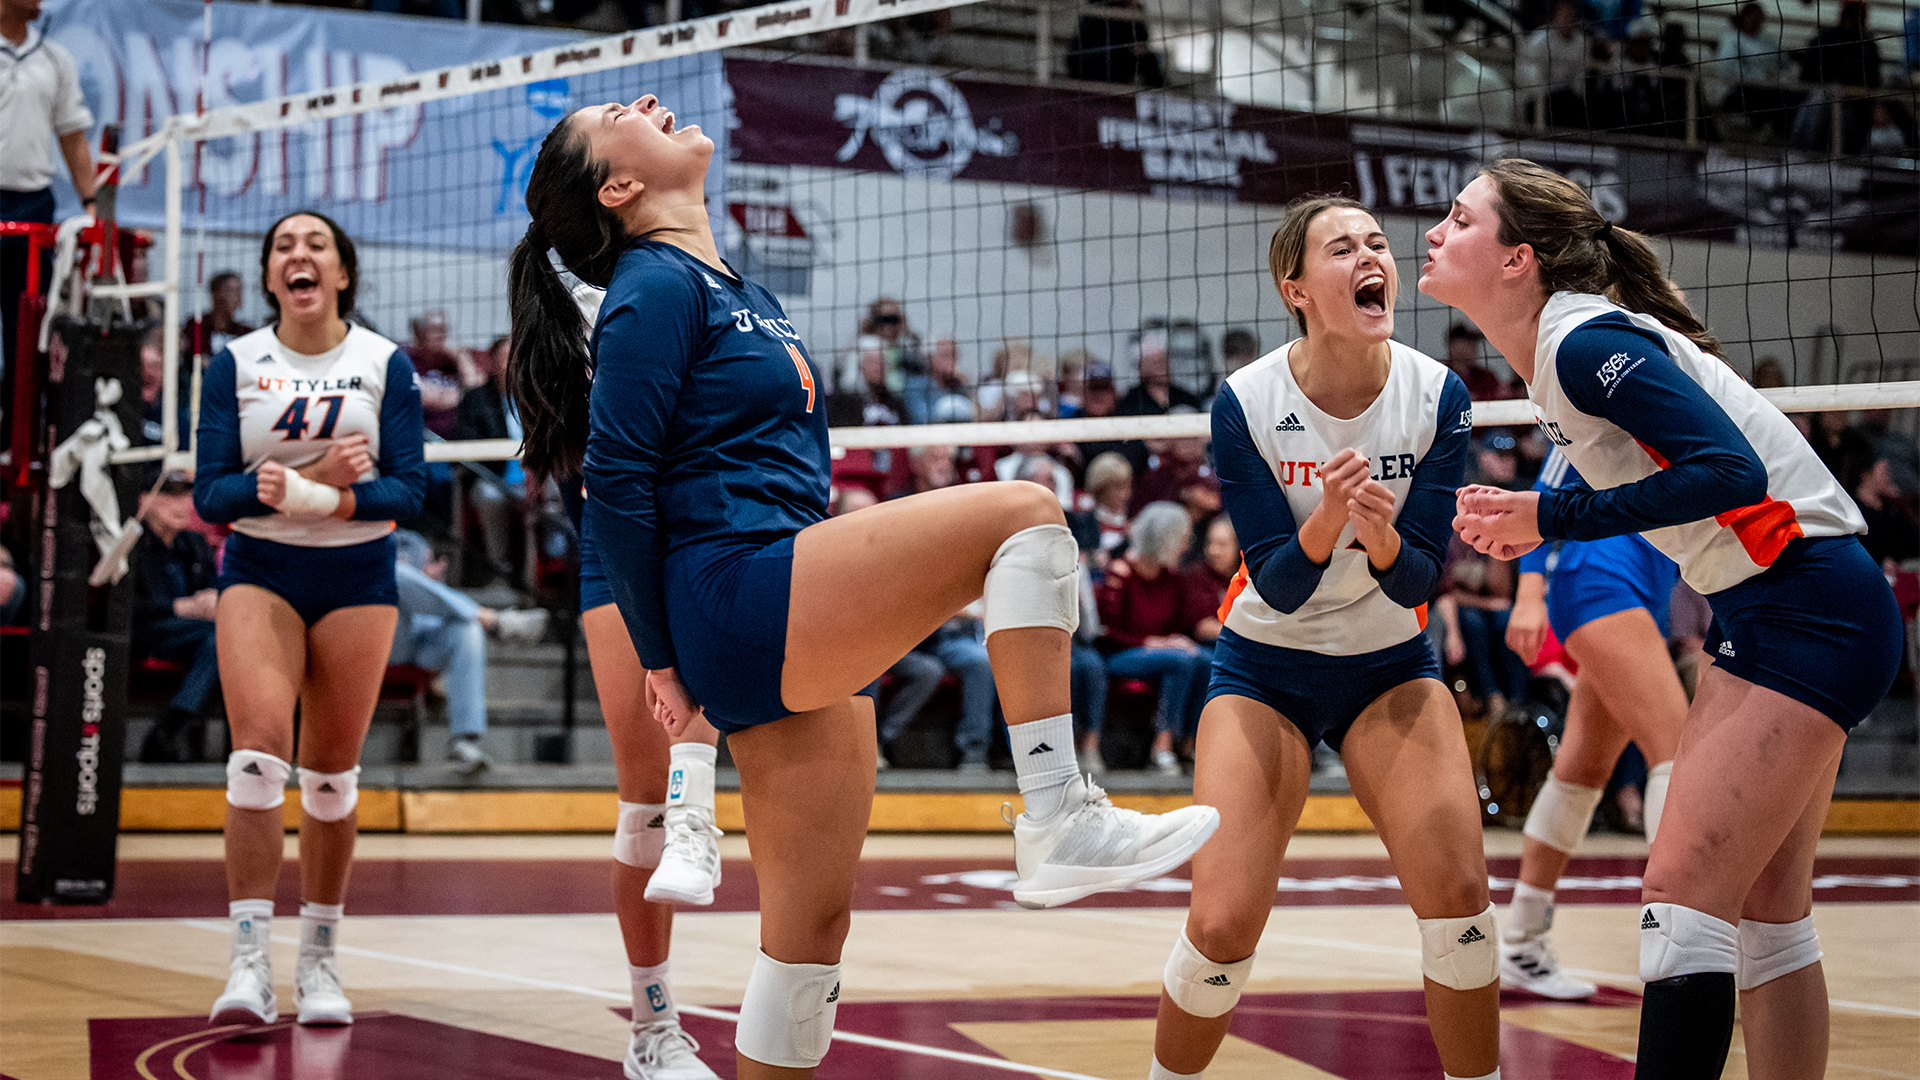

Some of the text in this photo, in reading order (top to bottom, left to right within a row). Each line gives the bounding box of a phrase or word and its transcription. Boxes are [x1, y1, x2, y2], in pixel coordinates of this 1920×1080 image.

[258, 376, 362, 392] UT TYLER
[781, 340, 816, 414] 4
[1275, 423, 1306, 432] adidas
[1459, 409, 1472, 426] LS
[1280, 460, 1317, 487] UT
[82, 648, 106, 722] sports
